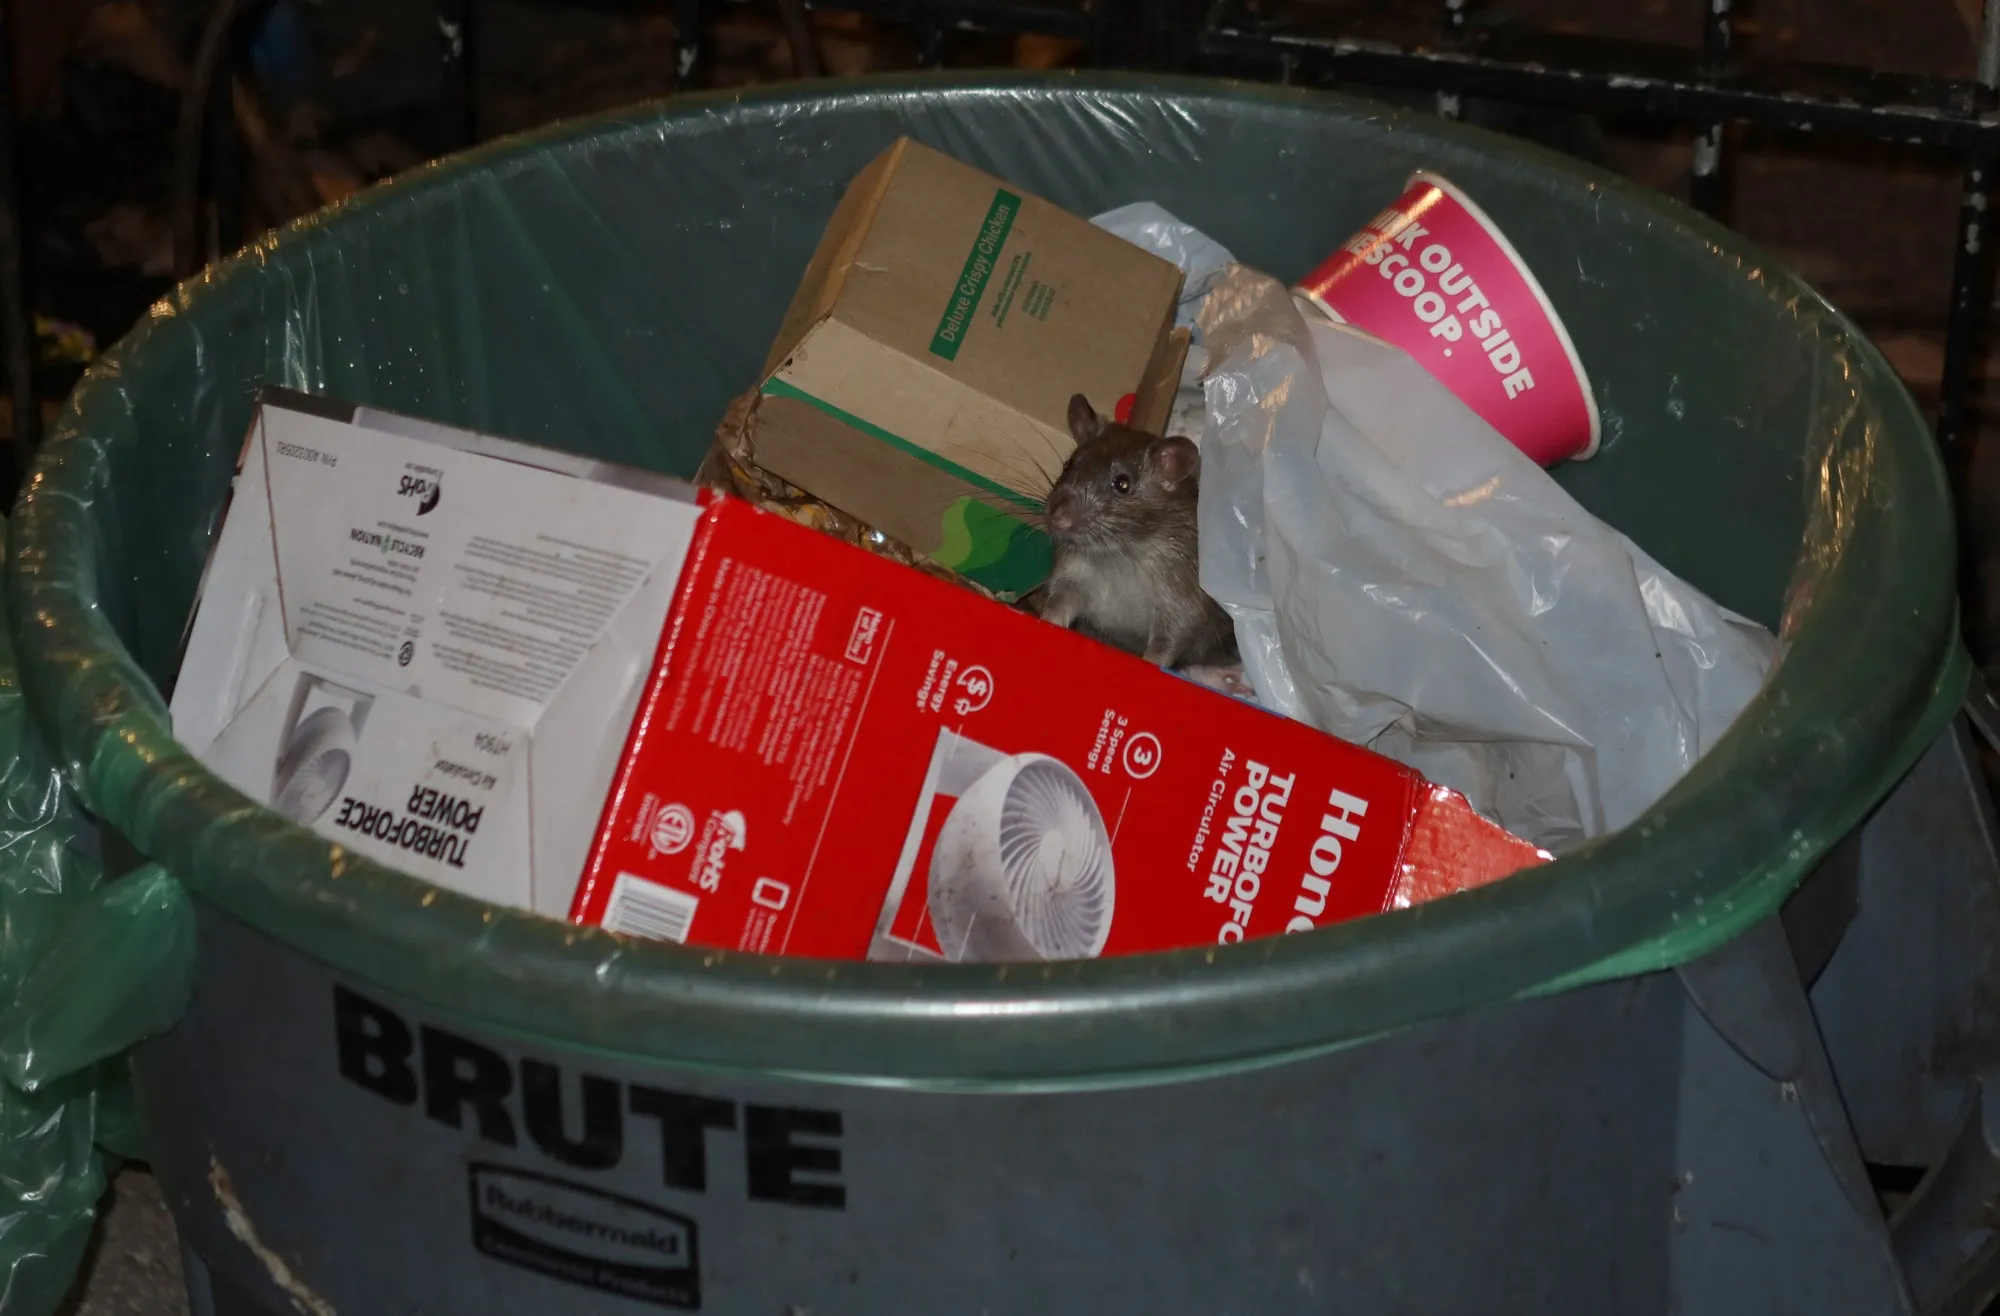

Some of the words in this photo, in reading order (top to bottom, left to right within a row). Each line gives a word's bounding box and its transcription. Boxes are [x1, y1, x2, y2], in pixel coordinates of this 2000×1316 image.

[939, 296, 970, 343] Deluxe
[960, 255, 992, 297] Crispy
[978, 204, 1010, 254] Chicken
[1420, 244, 1535, 400] OUTSIDE
[350, 528, 382, 548] NATION
[390, 539, 425, 559] RECYCLE
[930, 659, 959, 713] Energy
[1087, 708, 1116, 771] Settings
[1116, 715, 1129, 727] 3
[435, 759, 481, 786] Circulator
[1101, 729, 1125, 775] Speed
[1133, 747, 1152, 766] 3
[1217, 747, 1236, 777] Air
[406, 783, 485, 834] POWER
[481, 775, 498, 791] Air
[334, 797, 468, 869] TURBOFORCE
[1186, 779, 1226, 873] Circulator
[1204, 759, 1270, 904] POWER
[333, 984, 846, 1211] BRUTE
[485, 1183, 680, 1256] Rubbermaid
